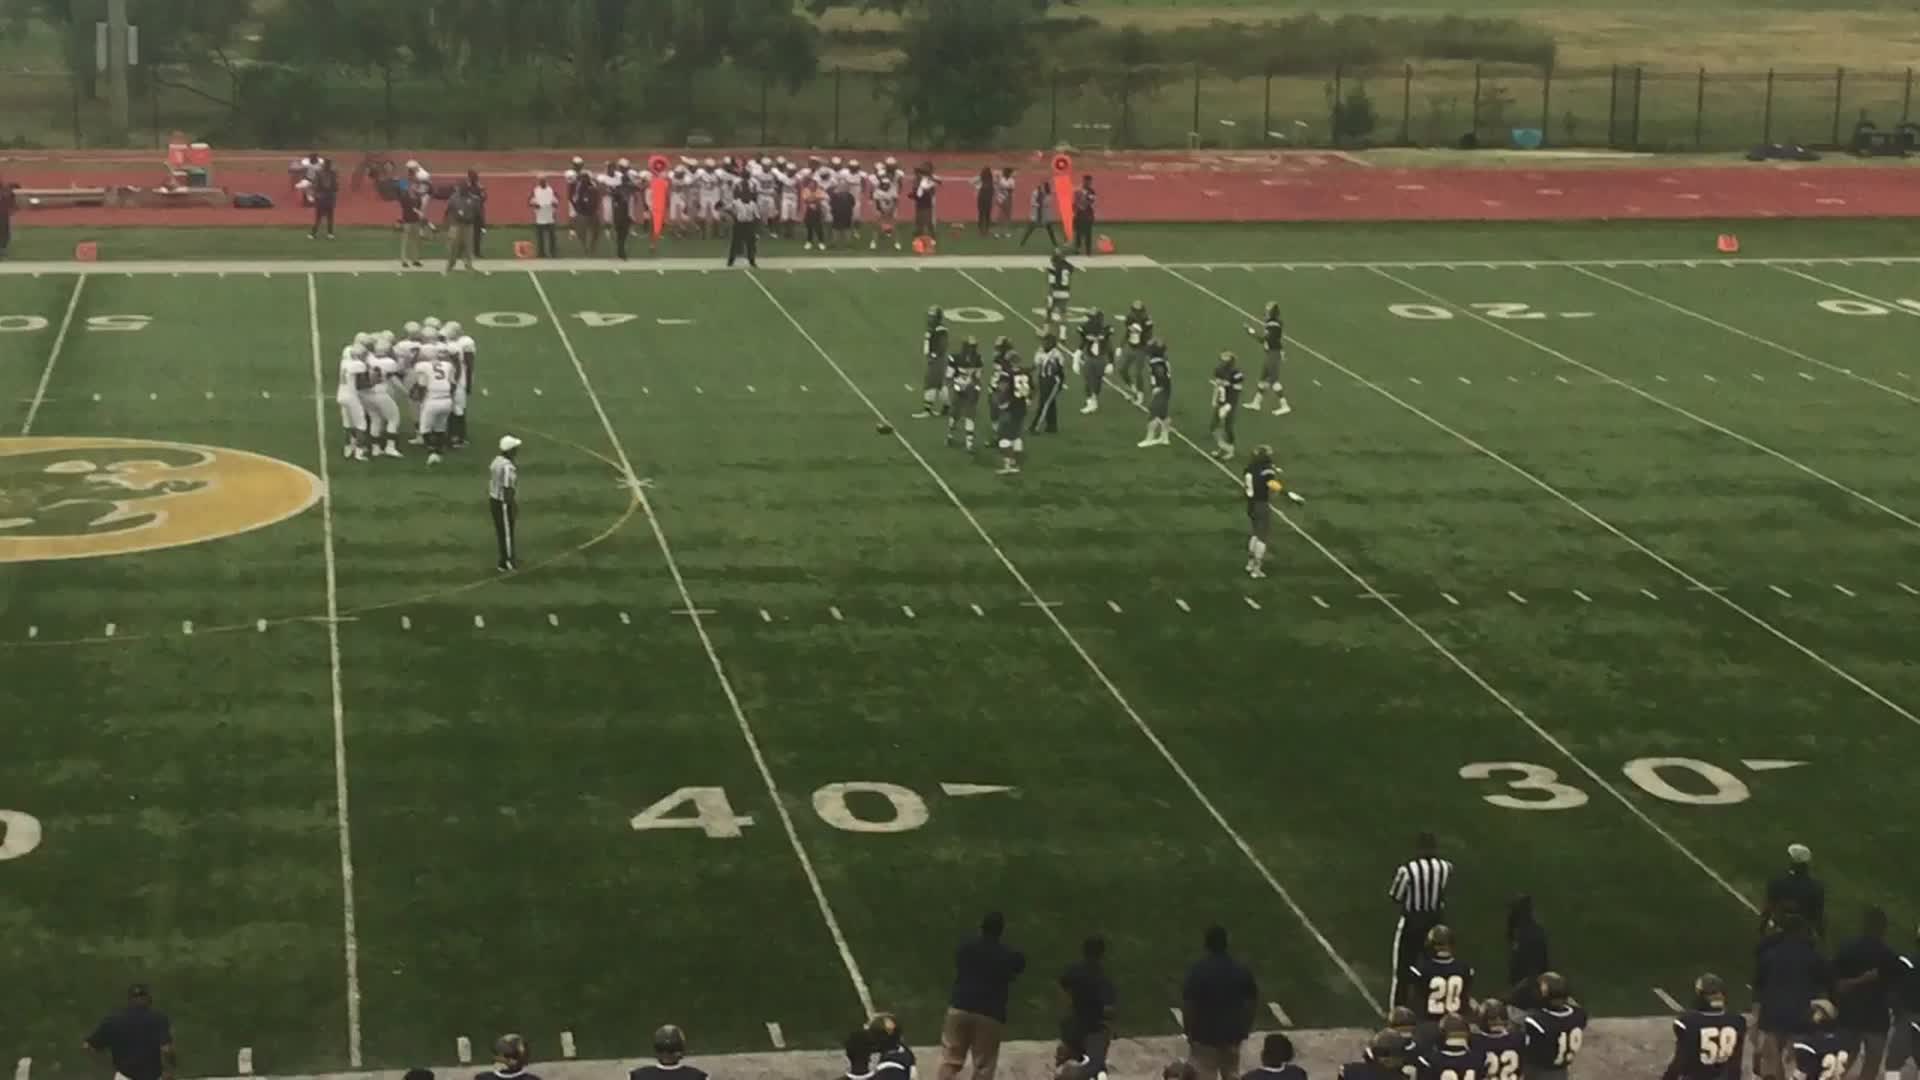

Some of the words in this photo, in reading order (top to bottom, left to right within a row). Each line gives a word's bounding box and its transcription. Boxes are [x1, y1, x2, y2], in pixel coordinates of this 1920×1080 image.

[1458, 757, 1750, 810] 30
[630, 782, 929, 839] 40
[1427, 975, 1463, 1014] 20
[1700, 1026, 1737, 1065] 58
